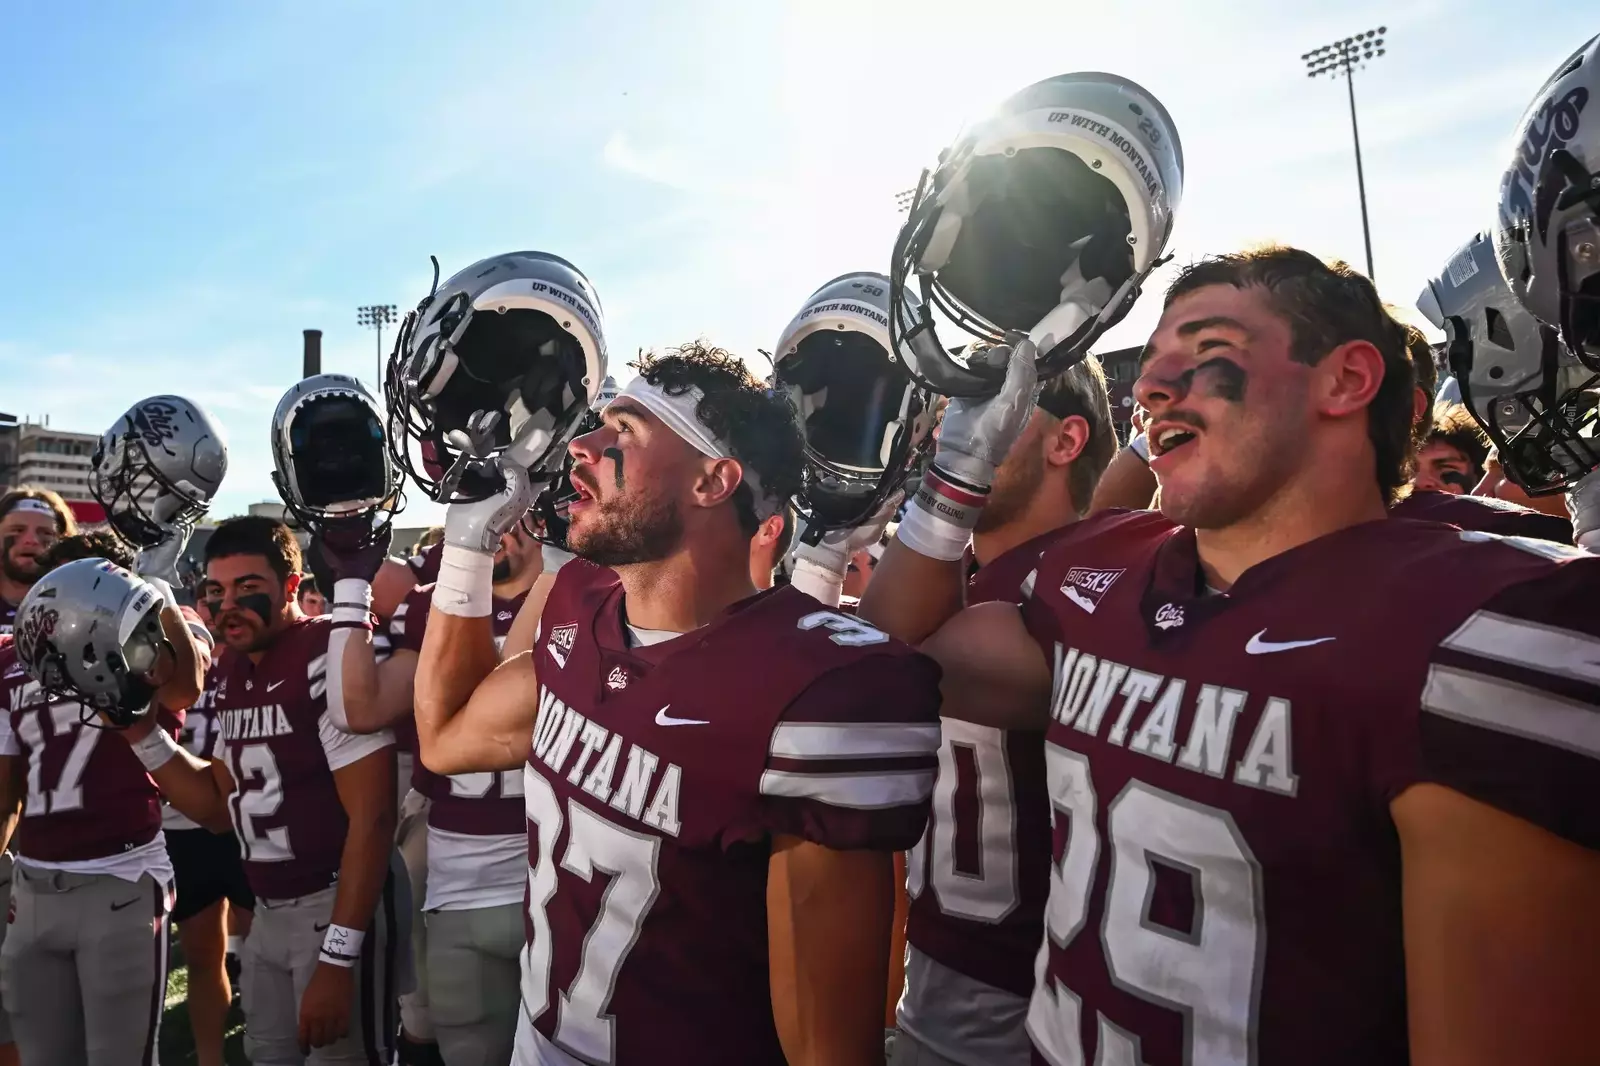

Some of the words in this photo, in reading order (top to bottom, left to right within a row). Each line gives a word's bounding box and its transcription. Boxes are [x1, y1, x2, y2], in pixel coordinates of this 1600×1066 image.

[1138, 116, 1162, 144] 29
[1048, 112, 1069, 123] UP
[1070, 114, 1111, 138] WITH
[1108, 131, 1158, 198] MONTANA
[532, 282, 548, 292] UP
[549, 286, 576, 307] WITH
[862, 285, 884, 297] 50
[800, 310, 813, 321] UP
[814, 303, 840, 314] WITH
[840, 303, 888, 327] MONTANA
[936, 502, 964, 520] UNITED
[133, 601, 142, 612] UP
[1155, 603, 1184, 628] Griz
[218, 704, 294, 739] MONTANA
[1050, 640, 1299, 798] MONTANA
[25, 701, 103, 817] 17
[532, 684, 682, 838] MONTANA
[226, 743, 295, 862] 12
